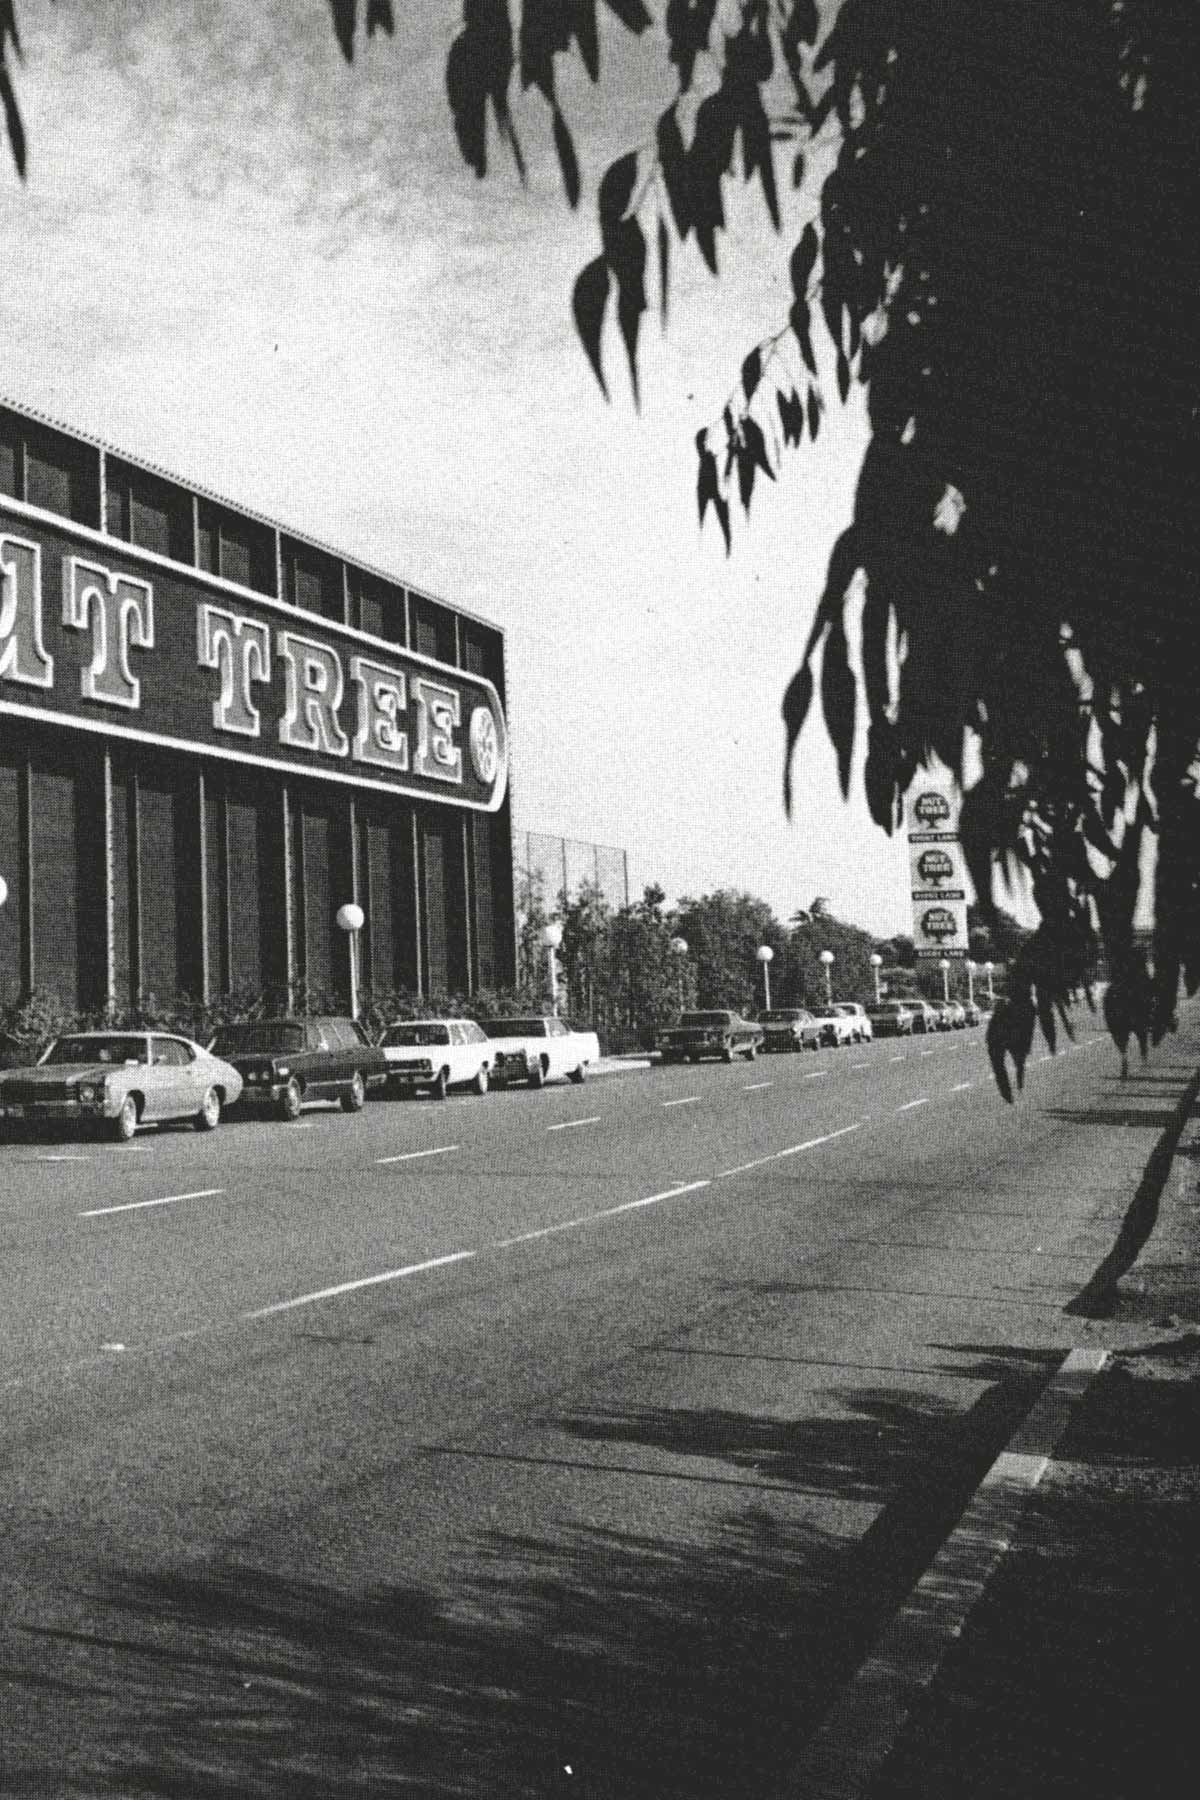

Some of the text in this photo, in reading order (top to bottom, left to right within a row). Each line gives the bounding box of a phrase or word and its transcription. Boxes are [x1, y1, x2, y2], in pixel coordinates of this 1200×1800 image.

[198, 604, 463, 784] TREE
[921, 797, 941, 806] NUT
[918, 806, 946, 814] TREE
[925, 855, 946, 863] NUT
[922, 863, 950, 872] TREE
[928, 913, 948, 921] NUT
[926, 921, 953, 930] TREE
